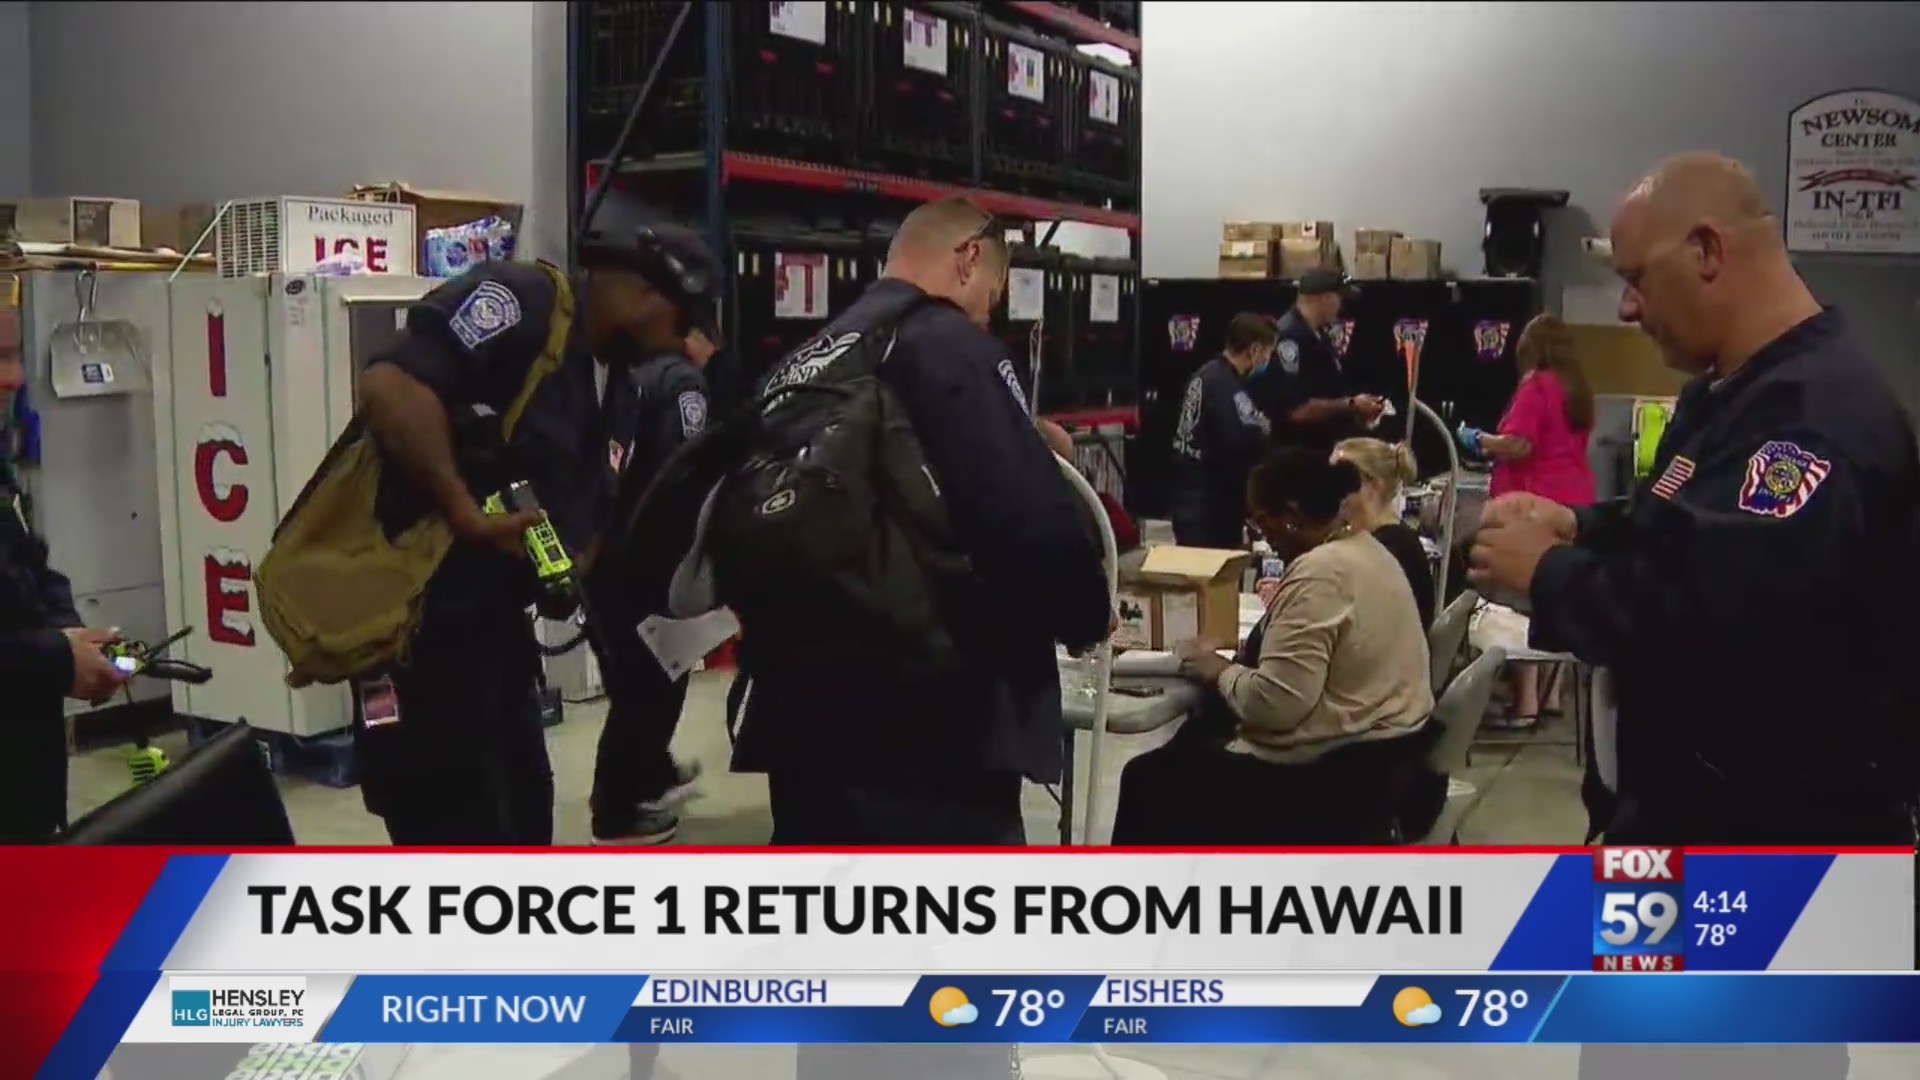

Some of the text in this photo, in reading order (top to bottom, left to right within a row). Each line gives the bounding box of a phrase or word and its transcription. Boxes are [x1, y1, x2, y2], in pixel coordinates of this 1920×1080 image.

[1821, 133, 1897, 148] CENTER
[308, 204, 393, 227] Packaged
[194, 303, 256, 647] ICE
